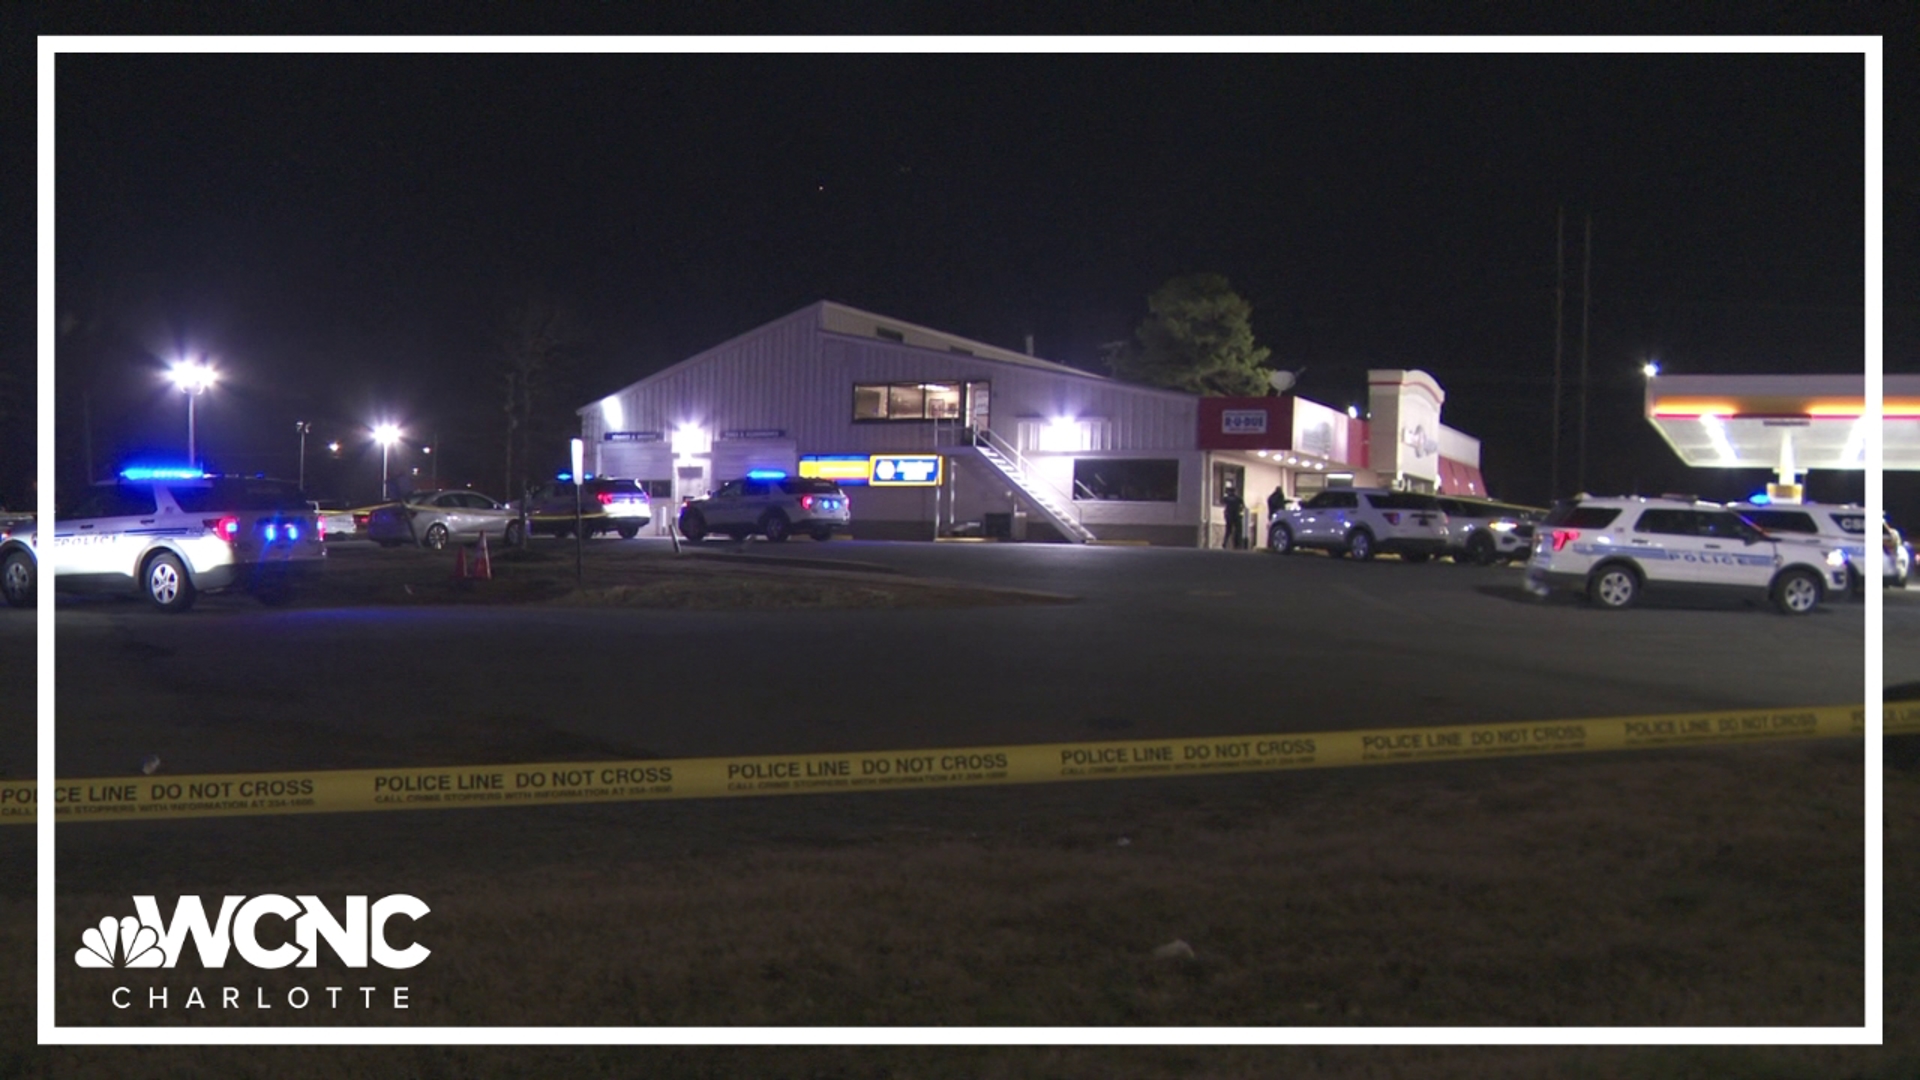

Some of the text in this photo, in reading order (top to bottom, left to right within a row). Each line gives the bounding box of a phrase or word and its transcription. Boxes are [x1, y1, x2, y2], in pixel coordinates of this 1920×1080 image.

[1668, 552, 1749, 566] POLICE
[1362, 726, 1586, 750] POLICE LINE DO NOT CROSS
[1061, 739, 1316, 764] POLICE LINE DO NOT CROSS
[728, 753, 1008, 779] POLICE LINE DO NOT CROSS
[2, 779, 314, 804] POCE LINE DO NOT CROSS
[374, 767, 673, 792] POLICE LINE DO NOT CROSS
[251, 799, 266, 808] AT
[375, 795, 402, 803] CALL
[612, 787, 625, 796] AT
